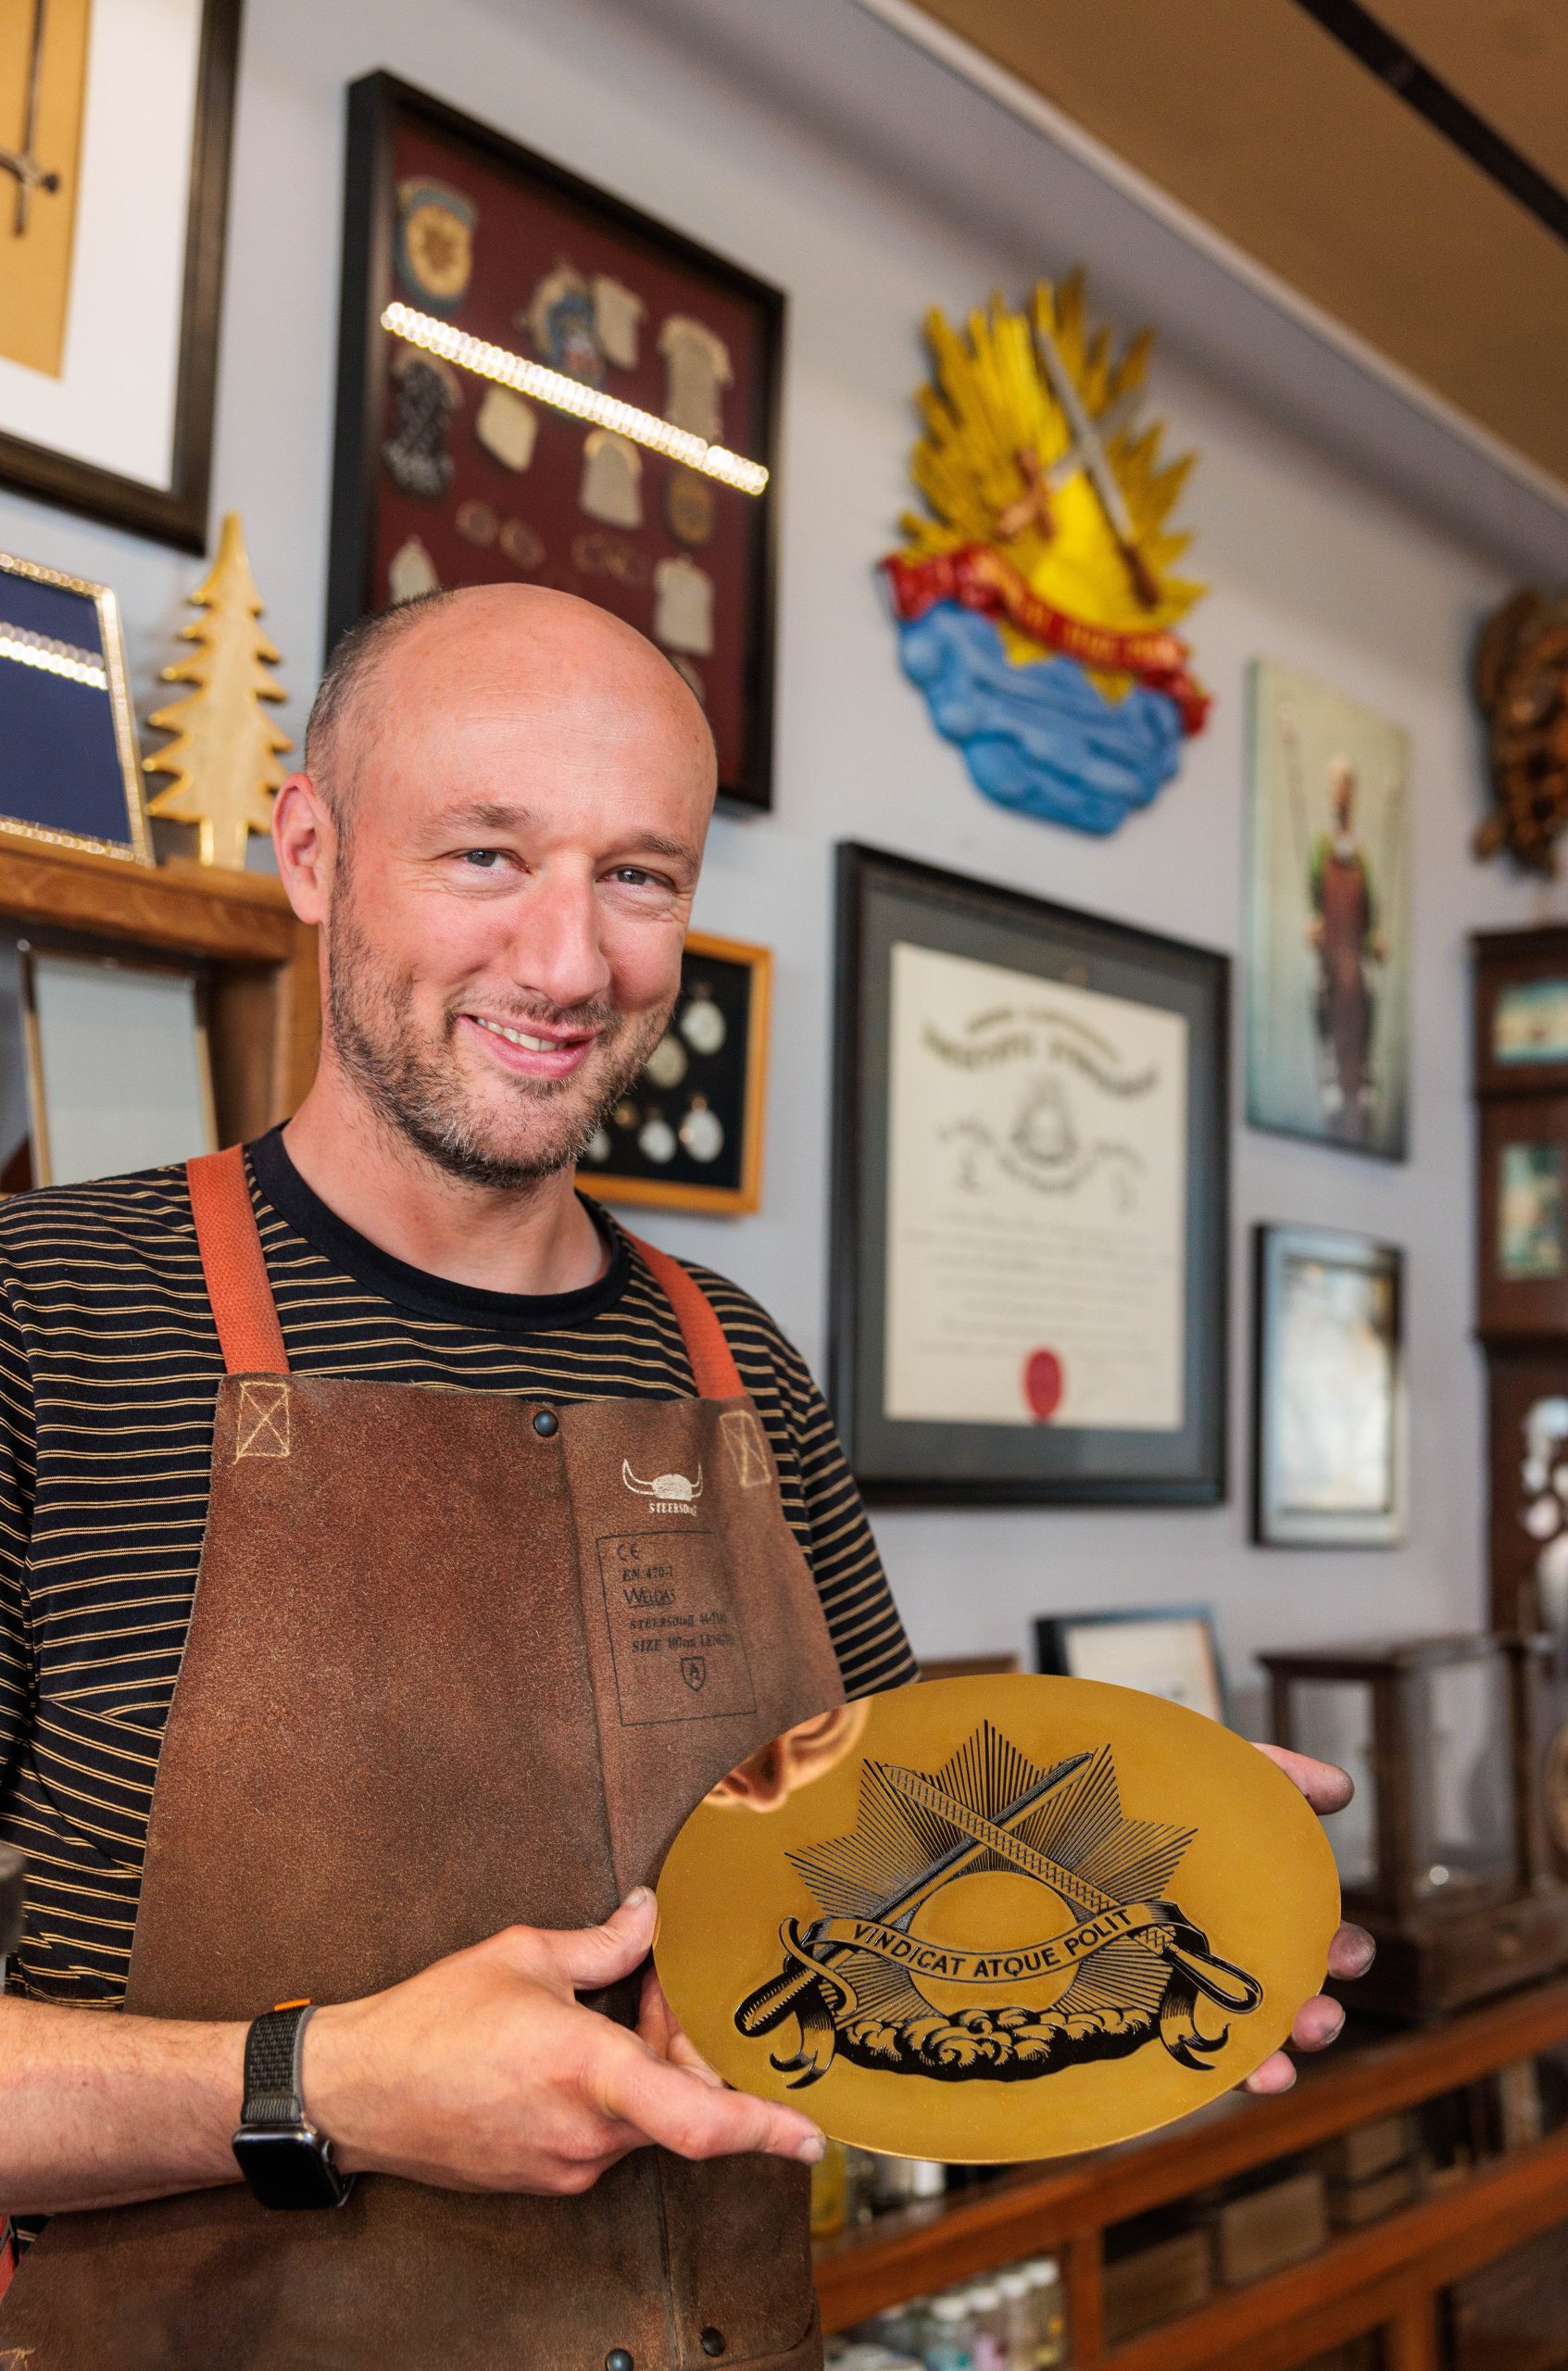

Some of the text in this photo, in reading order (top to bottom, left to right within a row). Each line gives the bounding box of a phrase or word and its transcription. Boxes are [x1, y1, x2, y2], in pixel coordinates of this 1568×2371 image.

[853, 1909, 1133, 1978] VINDICAT ATQUE POLIT
